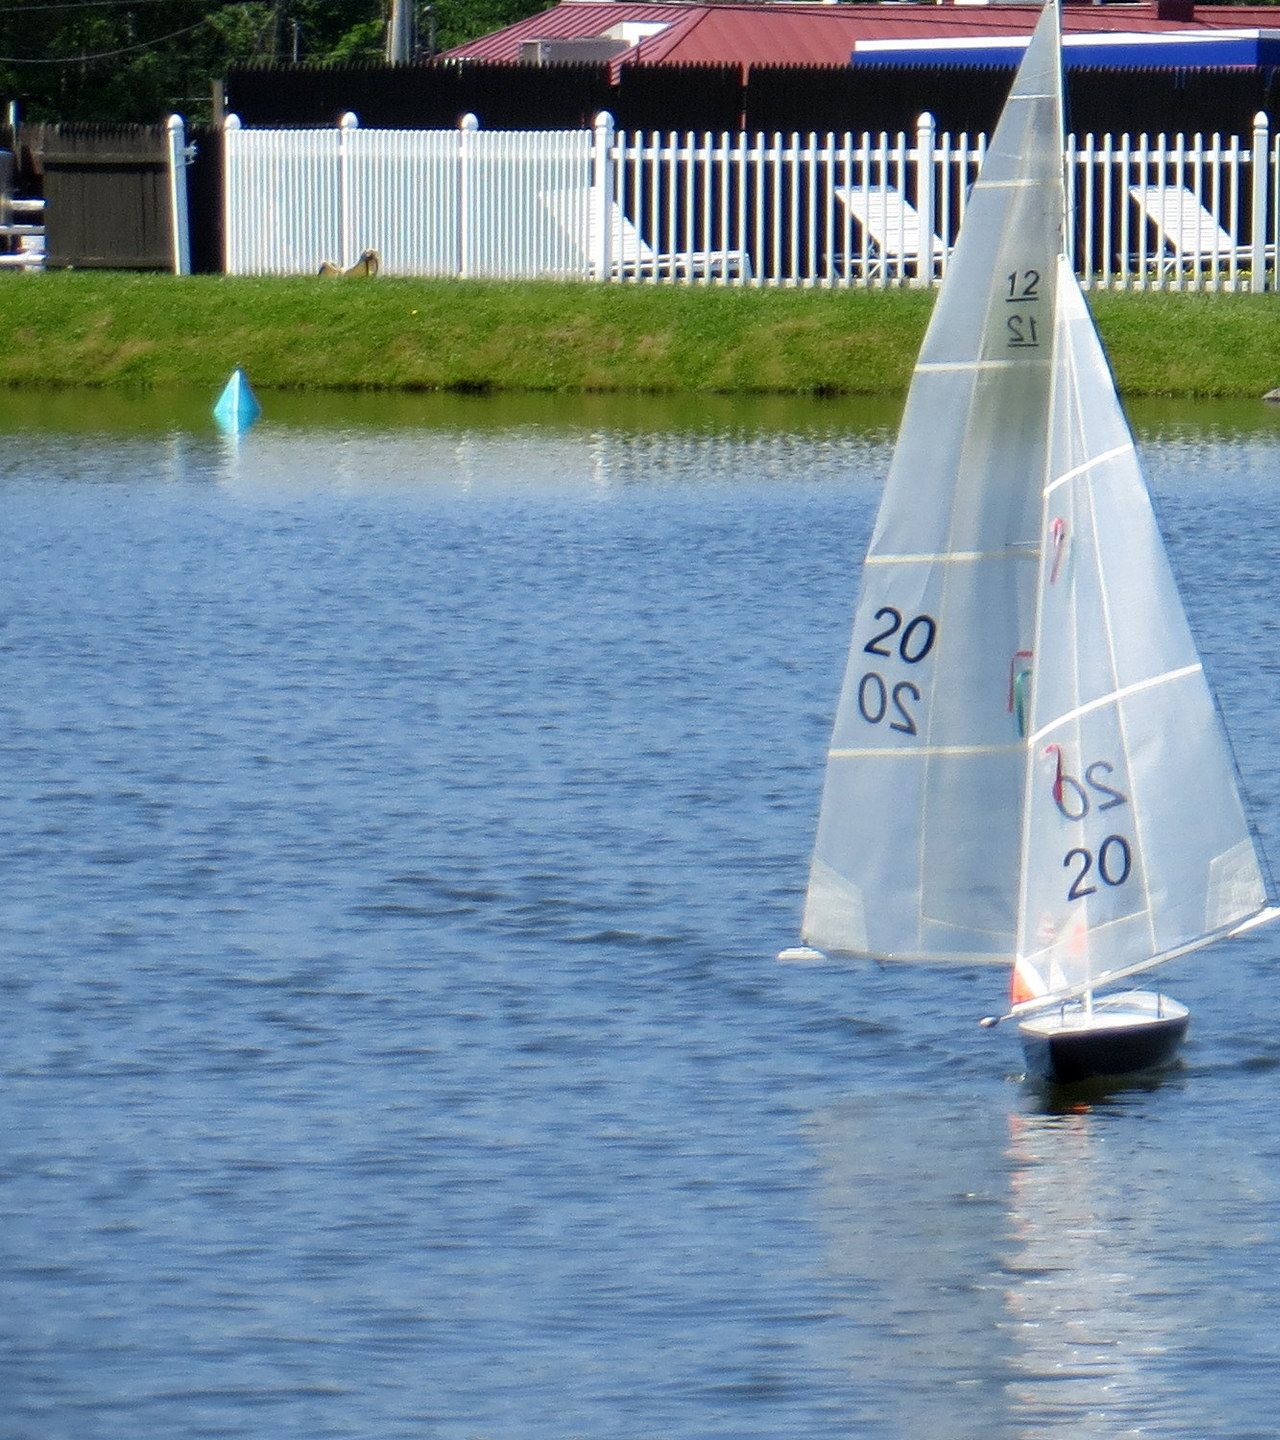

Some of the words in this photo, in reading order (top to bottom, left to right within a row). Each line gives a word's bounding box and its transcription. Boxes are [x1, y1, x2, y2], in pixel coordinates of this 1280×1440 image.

[1007, 270, 1040, 297] 12
[864, 606, 936, 664] 20
[1063, 834, 1131, 902] 20
